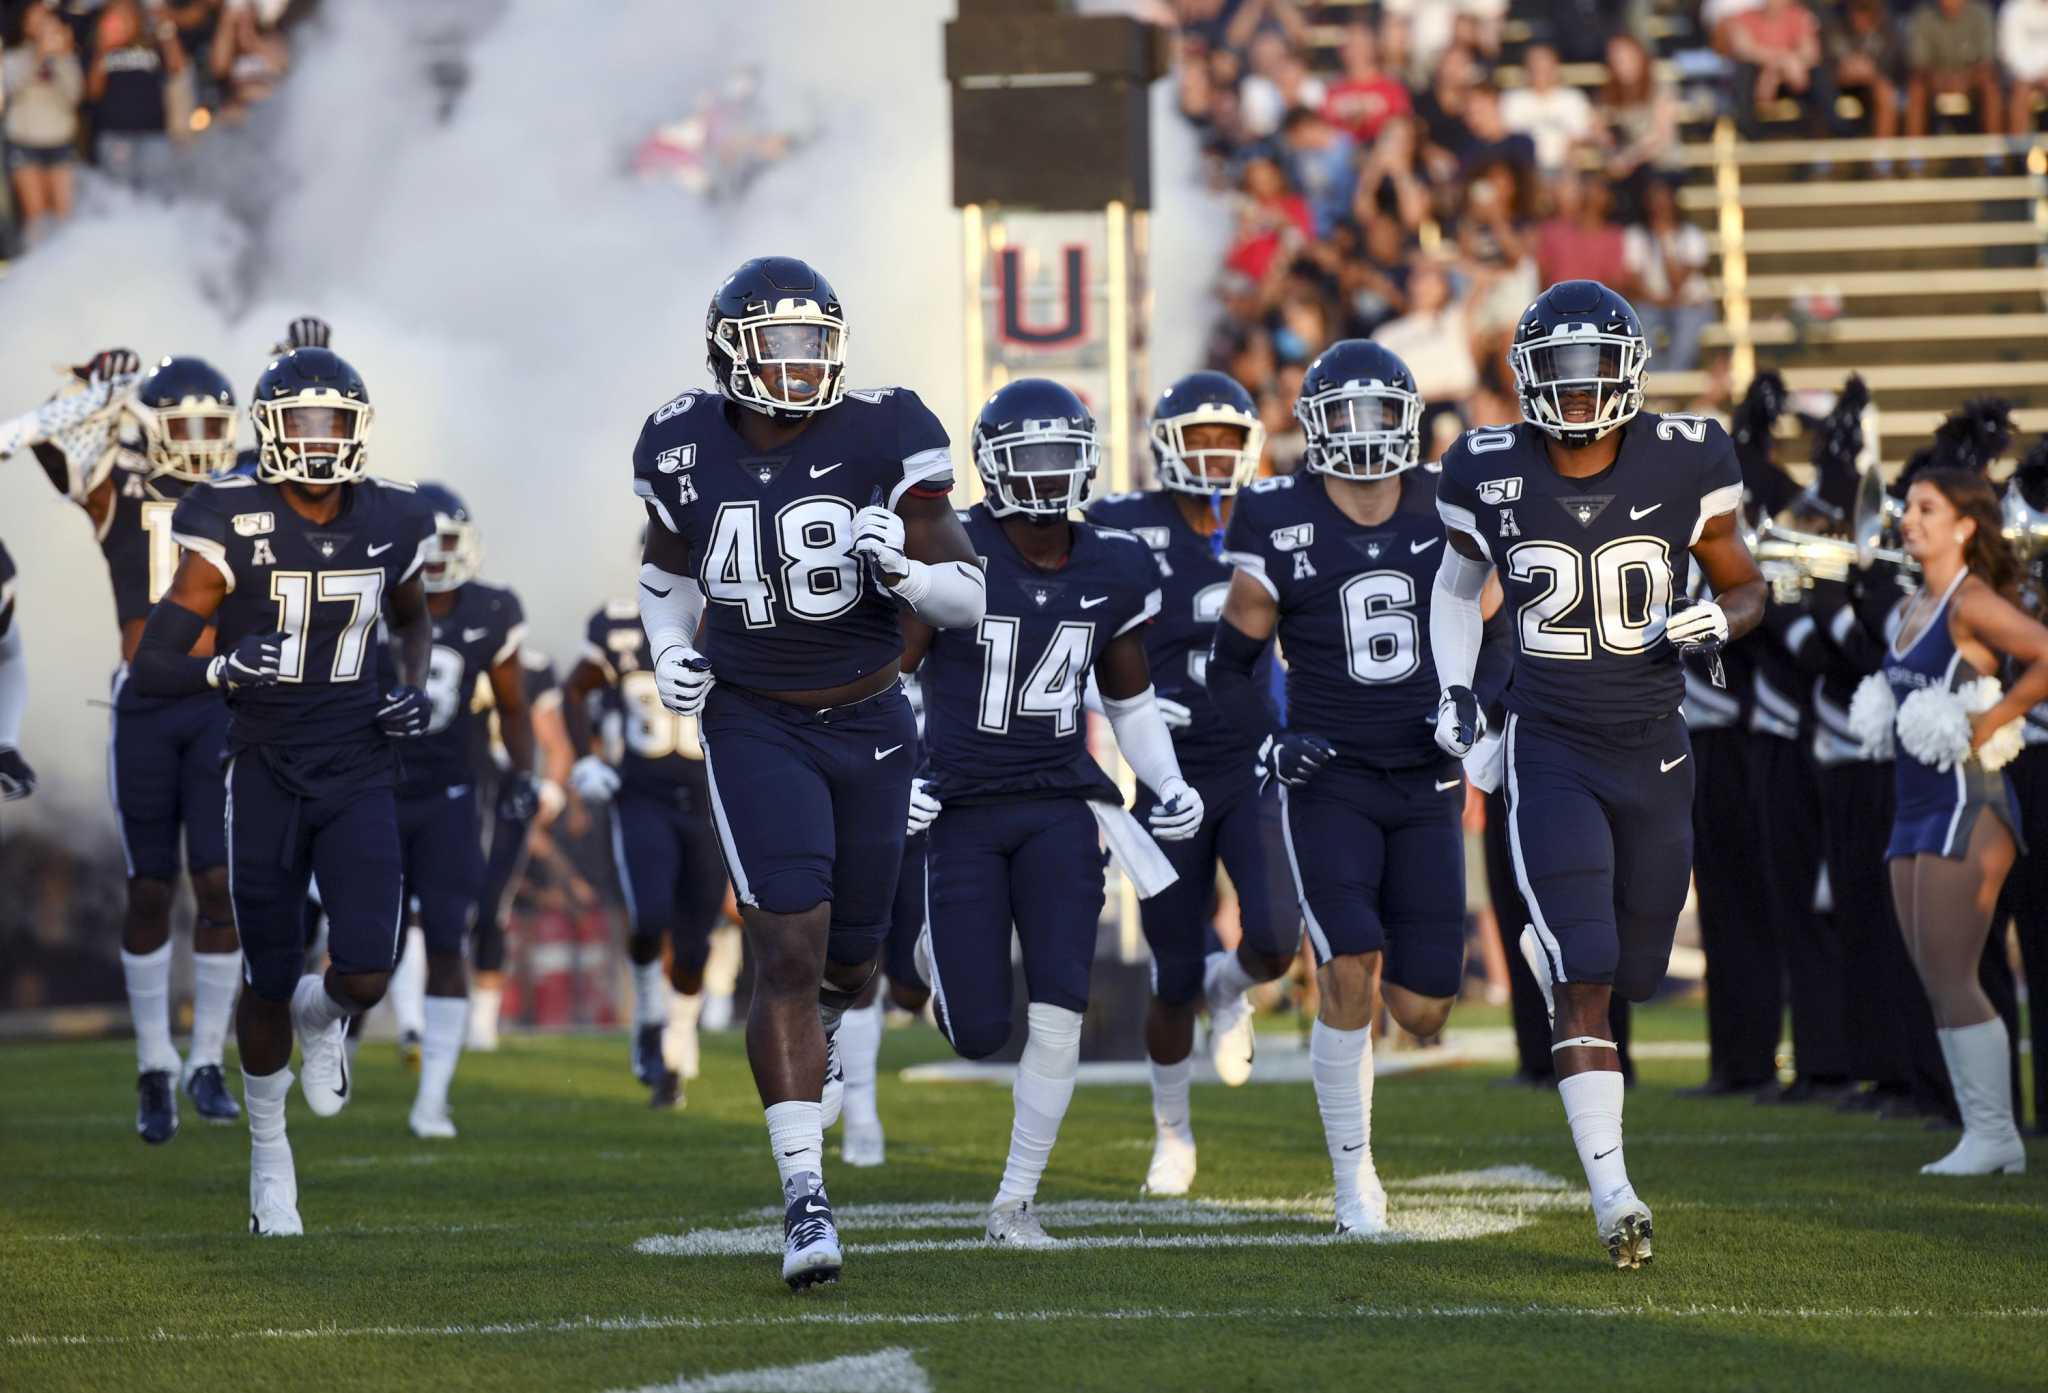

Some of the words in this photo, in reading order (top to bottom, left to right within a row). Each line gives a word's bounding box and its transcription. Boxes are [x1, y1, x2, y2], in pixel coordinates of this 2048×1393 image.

[996, 244, 1087, 350] U
[654, 389, 702, 426] 8
[1467, 424, 1516, 455] 0
[1656, 412, 1708, 444] 2
[1476, 477, 1523, 505] 150
[702, 494, 865, 630] 48
[1506, 535, 1674, 661] 20
[271, 566, 387, 684] 17
[976, 614, 1096, 738] 14
[1339, 569, 1421, 685] 6
